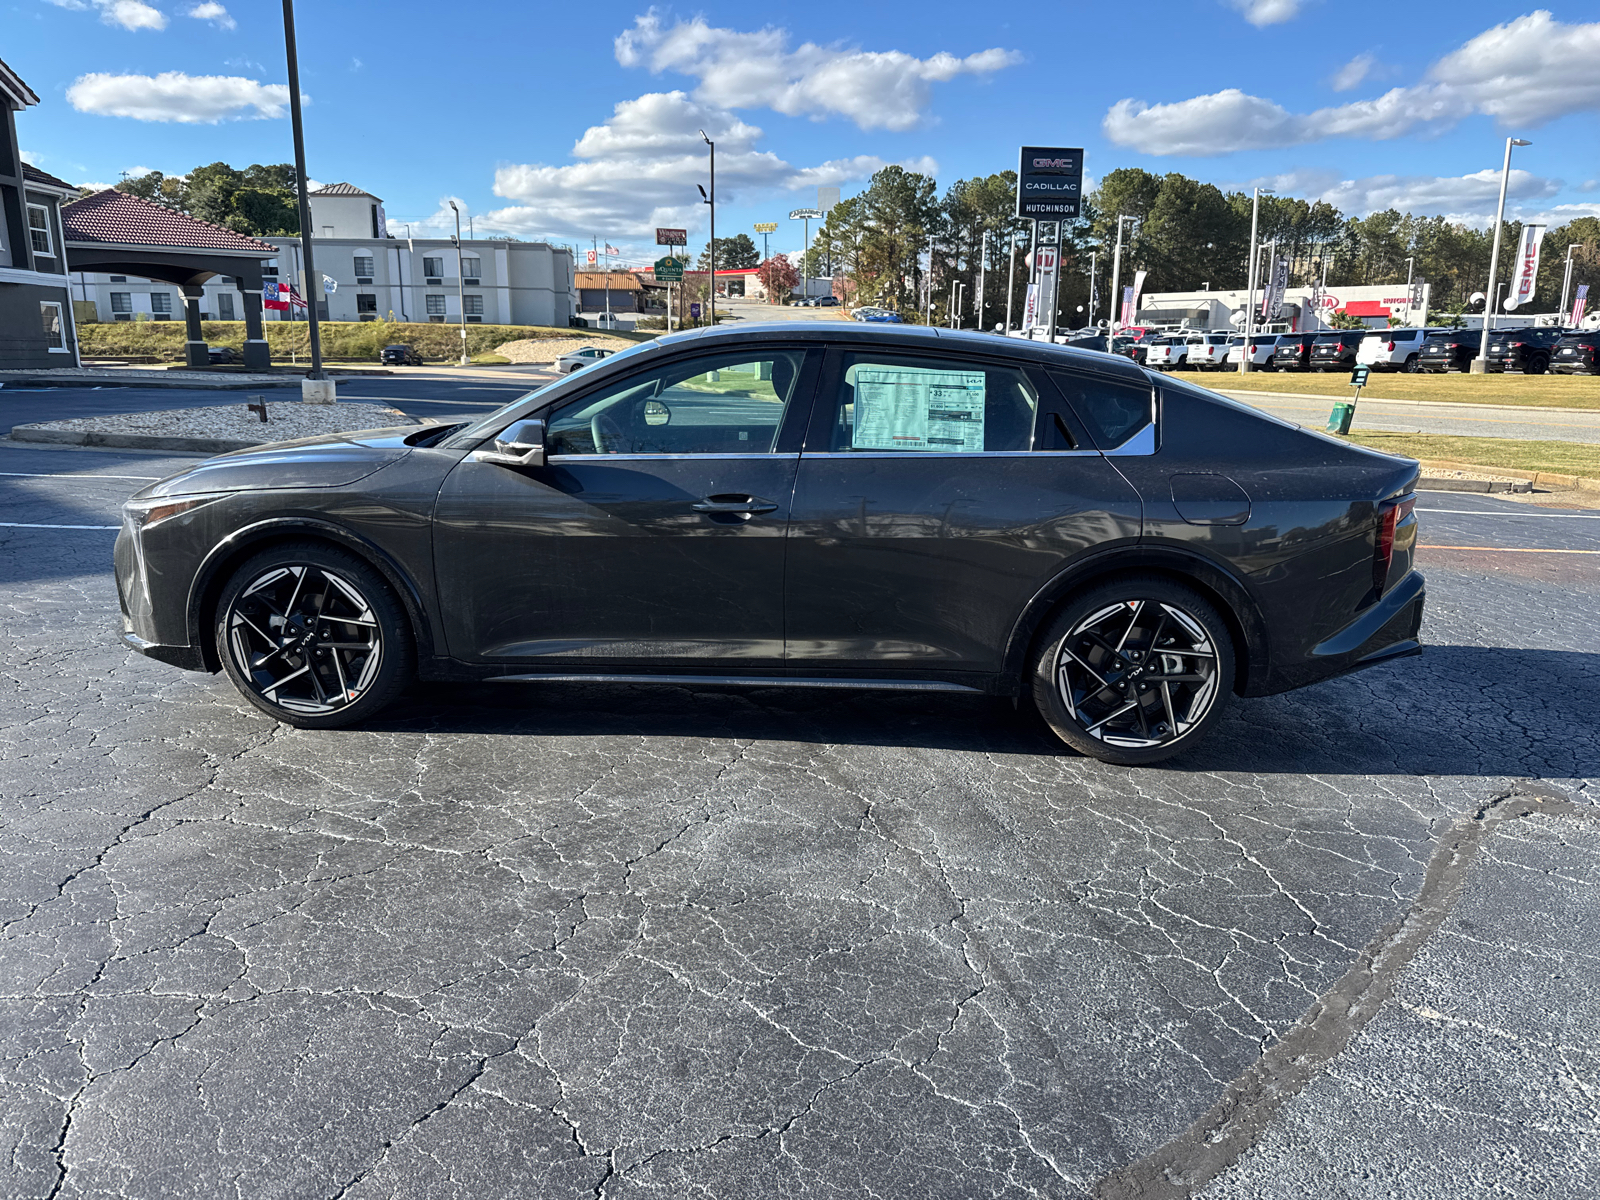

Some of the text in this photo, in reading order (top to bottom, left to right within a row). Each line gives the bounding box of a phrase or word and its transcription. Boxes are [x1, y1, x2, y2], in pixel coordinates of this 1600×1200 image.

[1033, 158, 1072, 168] GMC
[1025, 183, 1077, 191] CADILLAC
[1026, 204, 1075, 213] HUTCHINSON
[1519, 243, 1536, 295] GMC
[1272, 269, 1287, 316] CADILLAC
[1026, 293, 1036, 323] GMC
